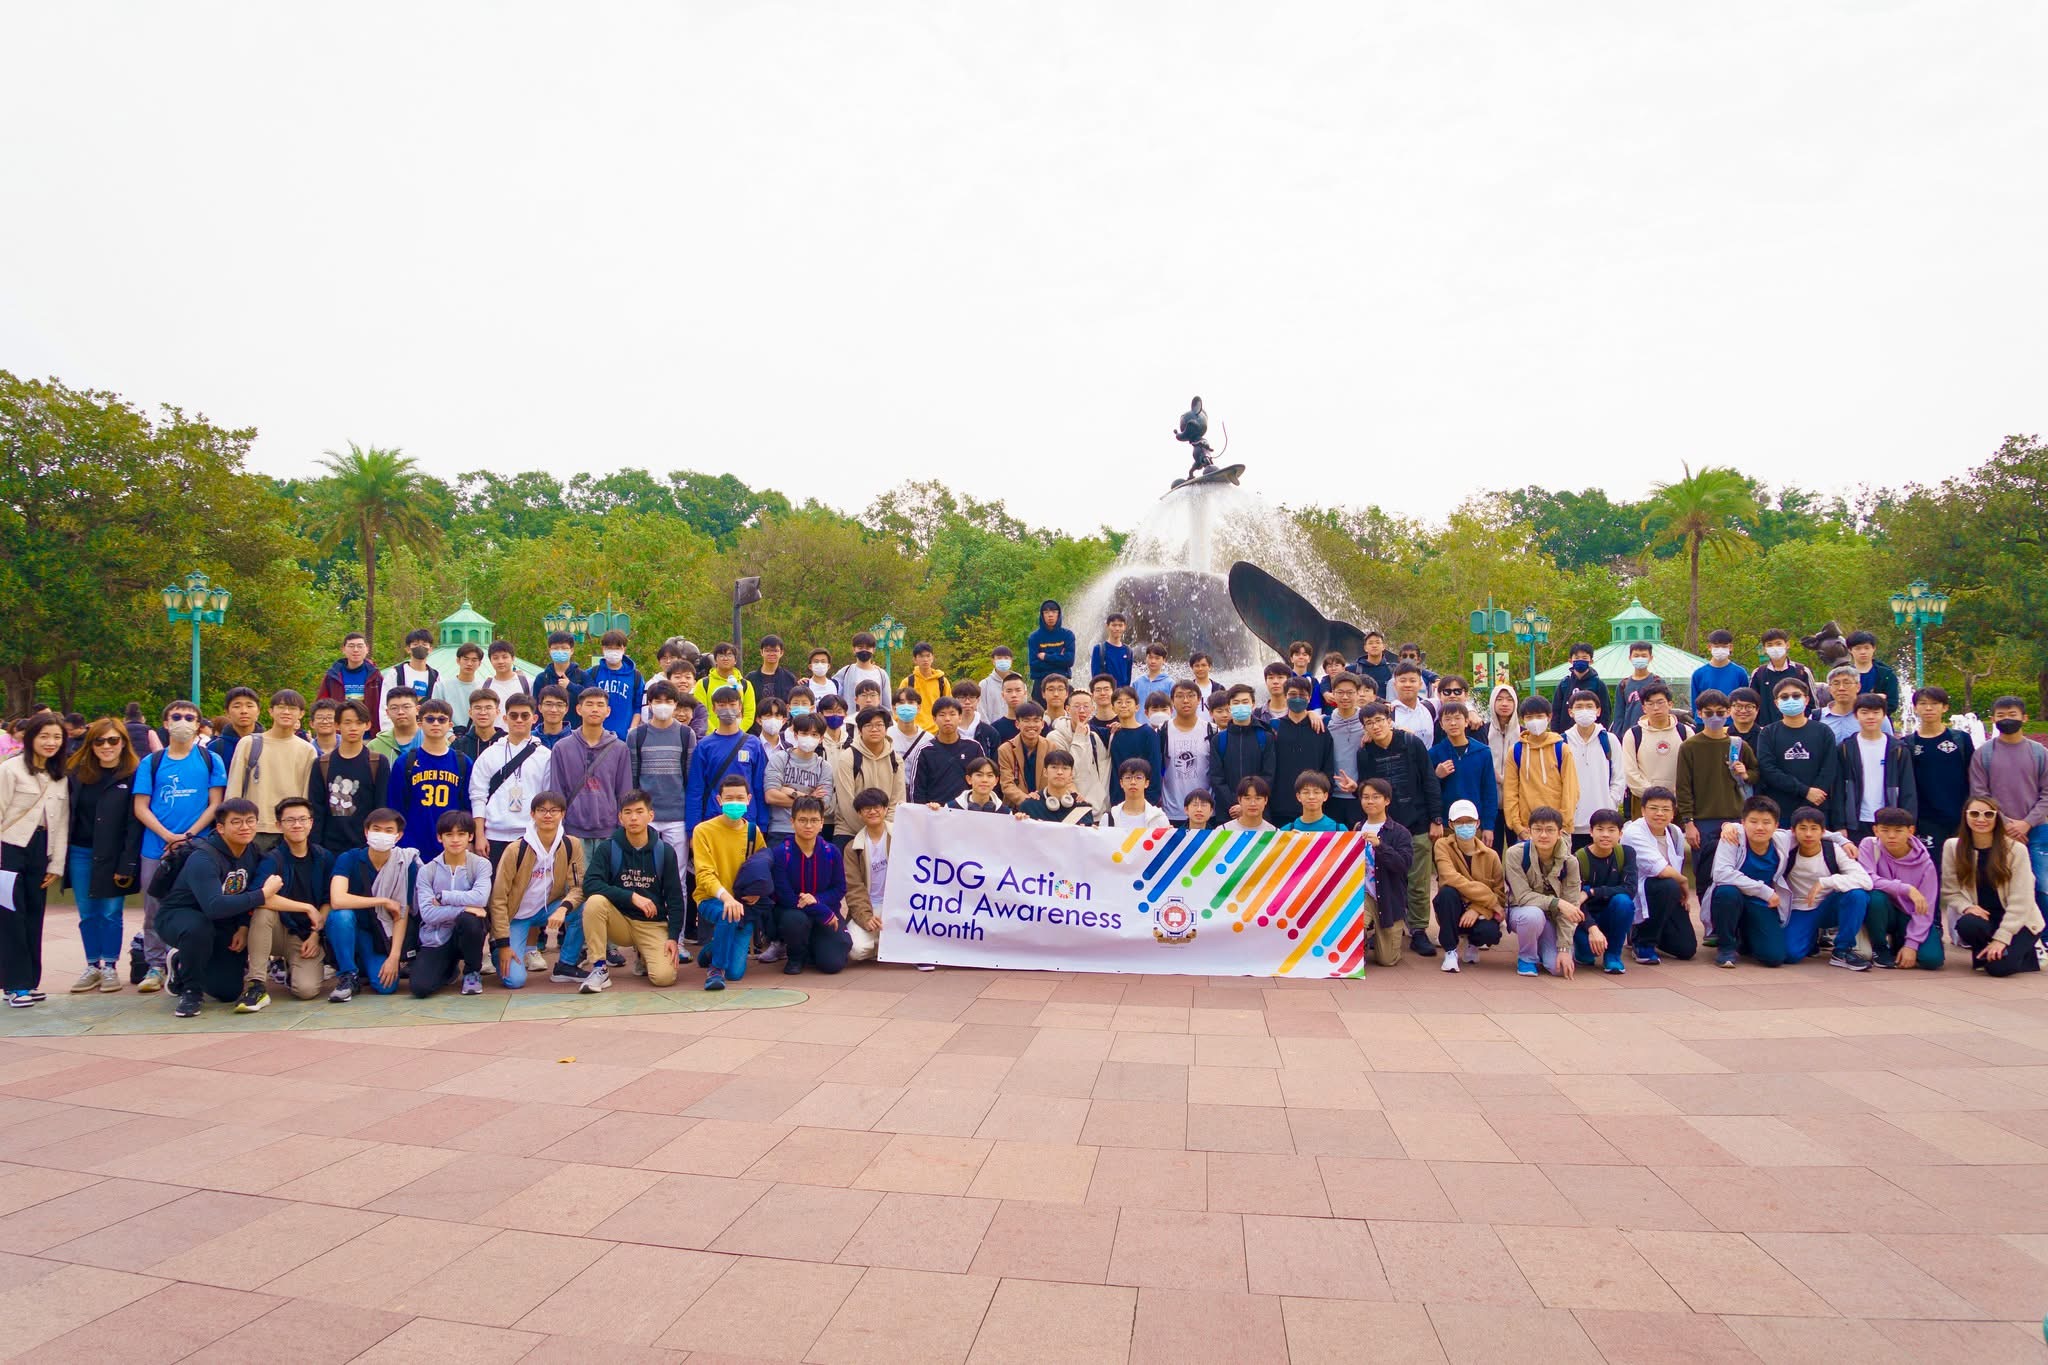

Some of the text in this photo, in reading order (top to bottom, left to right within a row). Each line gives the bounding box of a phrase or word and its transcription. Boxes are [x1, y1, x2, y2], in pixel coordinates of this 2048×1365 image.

[598, 679, 630, 699] EAGLE
[412, 769, 460, 787] GOLDEN STATE
[421, 784, 450, 807] 30
[912, 855, 1092, 901] SDG Action
[909, 890, 1122, 929] and Awareness
[905, 913, 984, 941] Month
